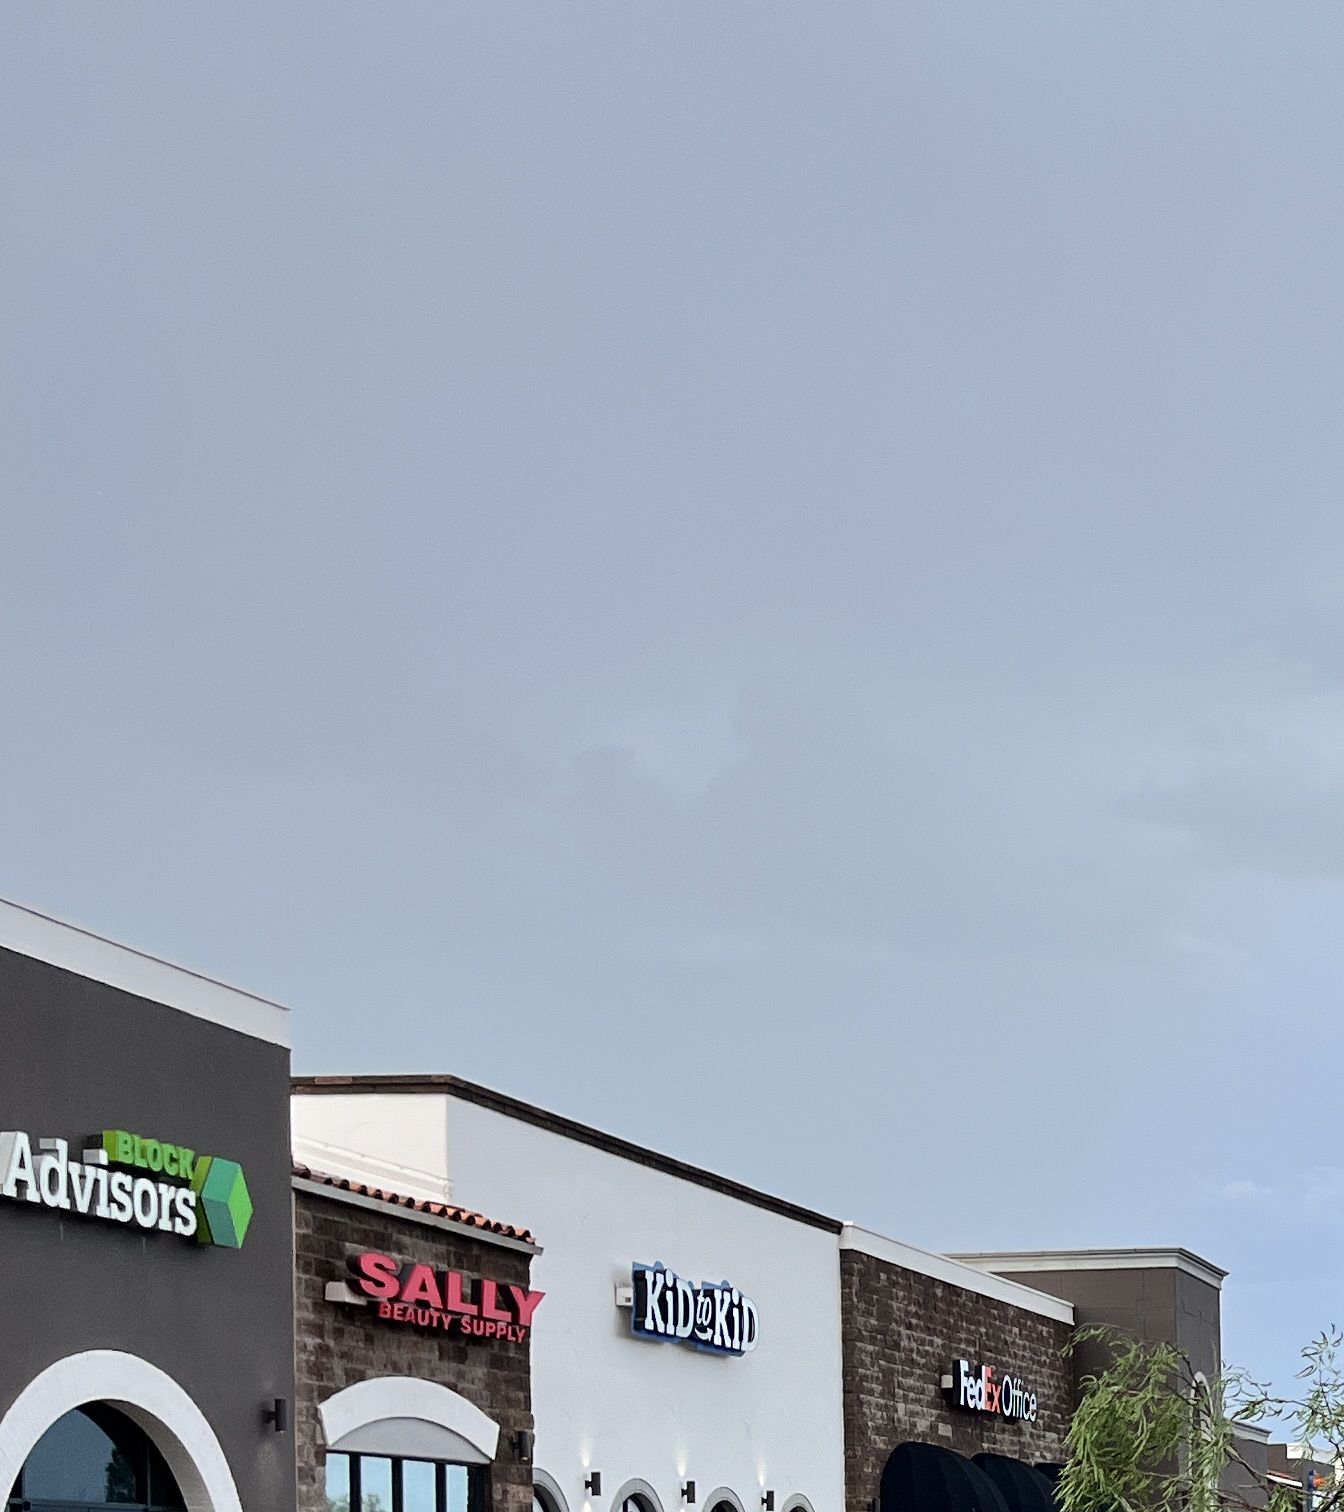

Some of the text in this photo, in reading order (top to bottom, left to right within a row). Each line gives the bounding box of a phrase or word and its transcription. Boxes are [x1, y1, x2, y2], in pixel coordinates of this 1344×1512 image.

[0, 1131, 197, 1237] Advisors
[116, 1129, 196, 1180] BLOCK
[358, 1252, 546, 1327] SALLY
[378, 1301, 526, 1344] BEAUTY SUPPLY
[959, 1359, 1038, 1422] FedEx Office
